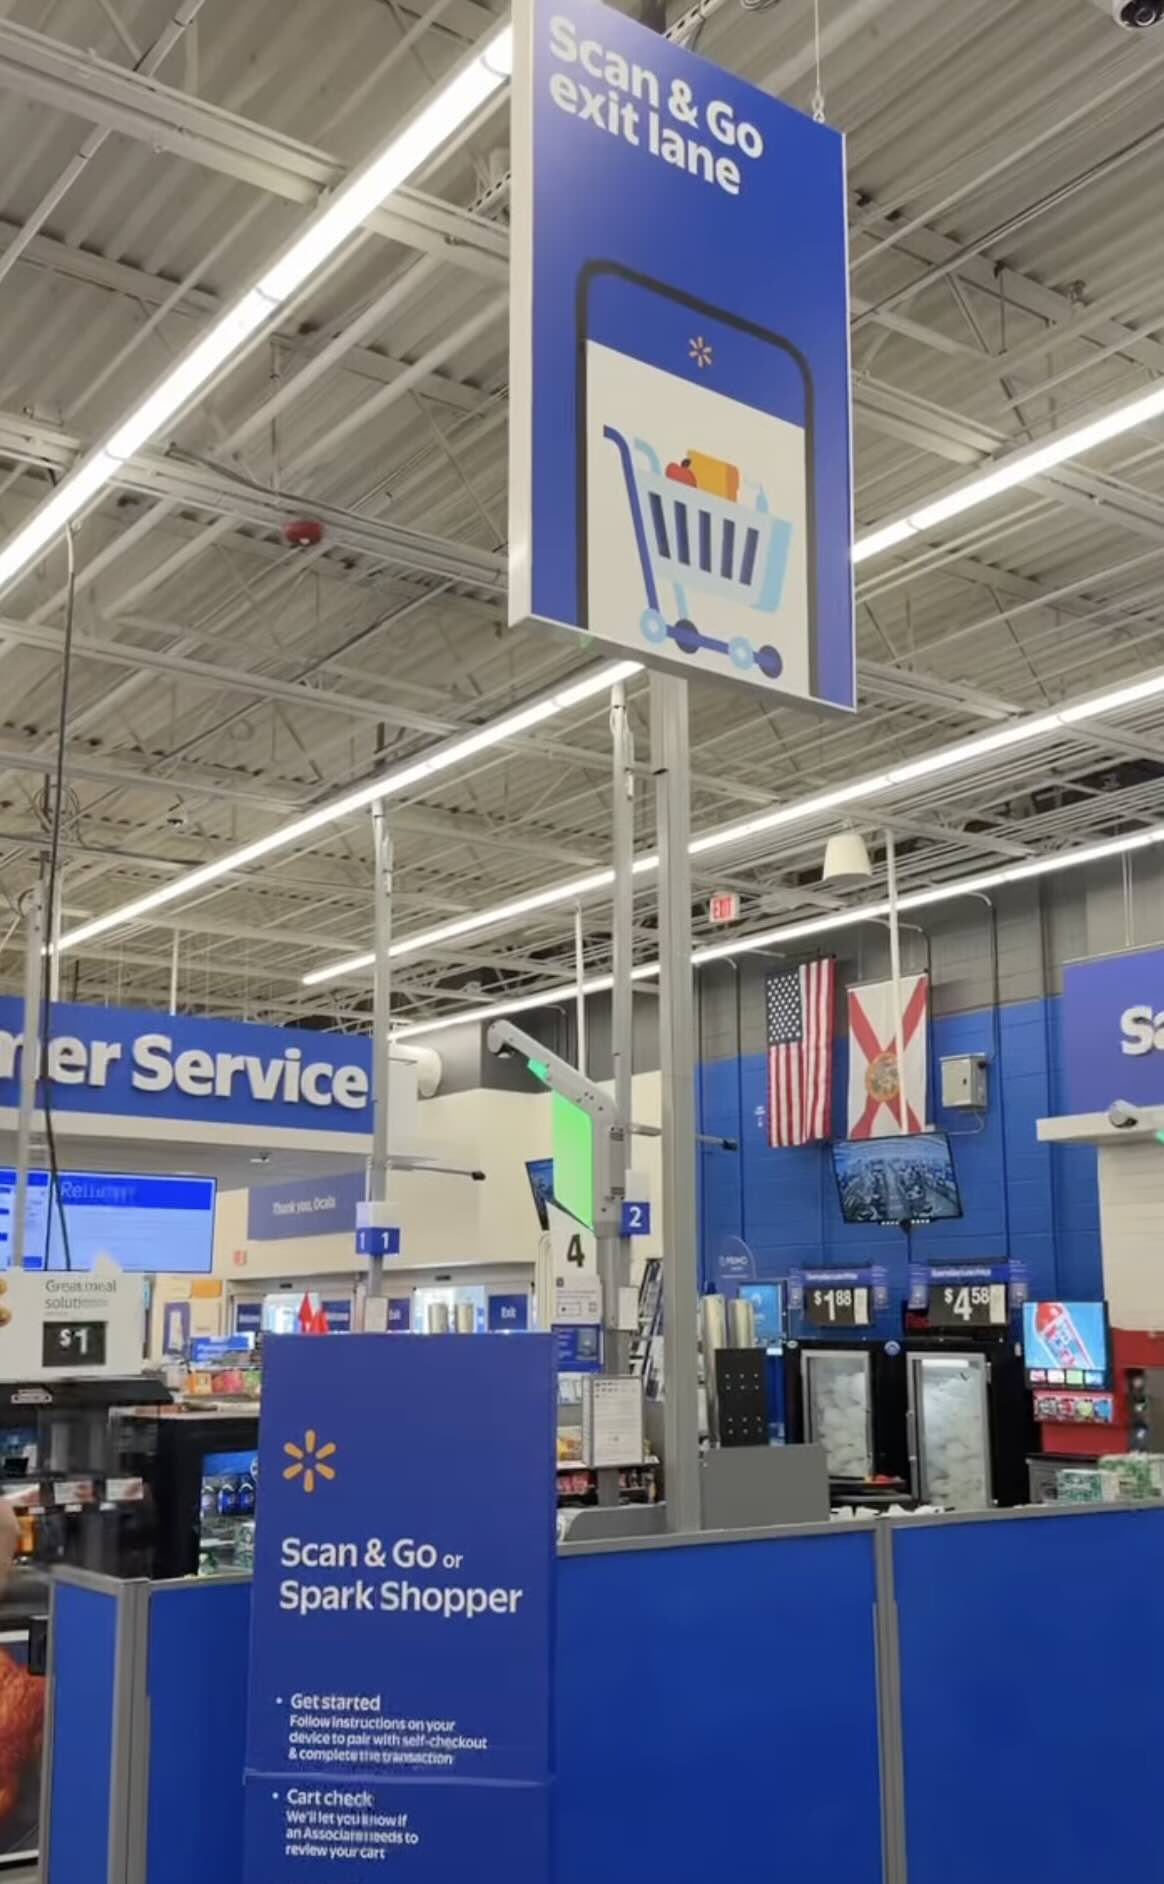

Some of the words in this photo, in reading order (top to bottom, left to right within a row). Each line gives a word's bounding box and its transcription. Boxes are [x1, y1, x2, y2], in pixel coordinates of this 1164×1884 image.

[550, 15, 659, 108] Scan
[668, 79, 699, 128] &
[706, 100, 764, 159] Go
[550, 72, 639, 146] exit
[648, 110, 741, 195] lane
[131, 1034, 369, 1109] Service
[629, 1206, 642, 1227] 2
[359, 1232, 365, 1250] 1
[381, 1232, 389, 1250] 1
[567, 1234, 585, 1268] 4
[45, 1279, 82, 1293] Great
[84, 1279, 117, 1292] meal
[45, 1296, 108, 1309] soluti
[60, 1327, 88, 1355] $1
[281, 1537, 358, 1567] Scan
[364, 1537, 386, 1567] &
[392, 1538, 437, 1568] Go
[442, 1553, 463, 1568] or
[279, 1580, 375, 1615] Spark
[380, 1581, 523, 1618] Shopper
[290, 1693, 319, 1710] Get
[321, 1694, 381, 1711] started
[290, 1714, 329, 1729] Follow
[332, 1716, 405, 1731] instructions
[408, 1719, 425, 1731] on
[426, 1720, 456, 1734] your
[289, 1731, 330, 1745] device
[332, 1733, 345, 1745] to
[347, 1732, 371, 1747] pair
[372, 1733, 400, 1746] with
[402, 1734, 488, 1749] self-checkout
[288, 1746, 298, 1760] &
[382, 1751, 453, 1765] transaction
[287, 1788, 321, 1805] Cart
[324, 1789, 373, 1807] check
[286, 1810, 316, 1824] We'll
[319, 1811, 335, 1824] let
[336, 1813, 359, 1827] you
[398, 1813, 408, 1827] if
[286, 1828, 301, 1839] an
[405, 1833, 419, 1845] to
[285, 1844, 327, 1857] review
[329, 1846, 358, 1860] your
[360, 1846, 386, 1859] cart
